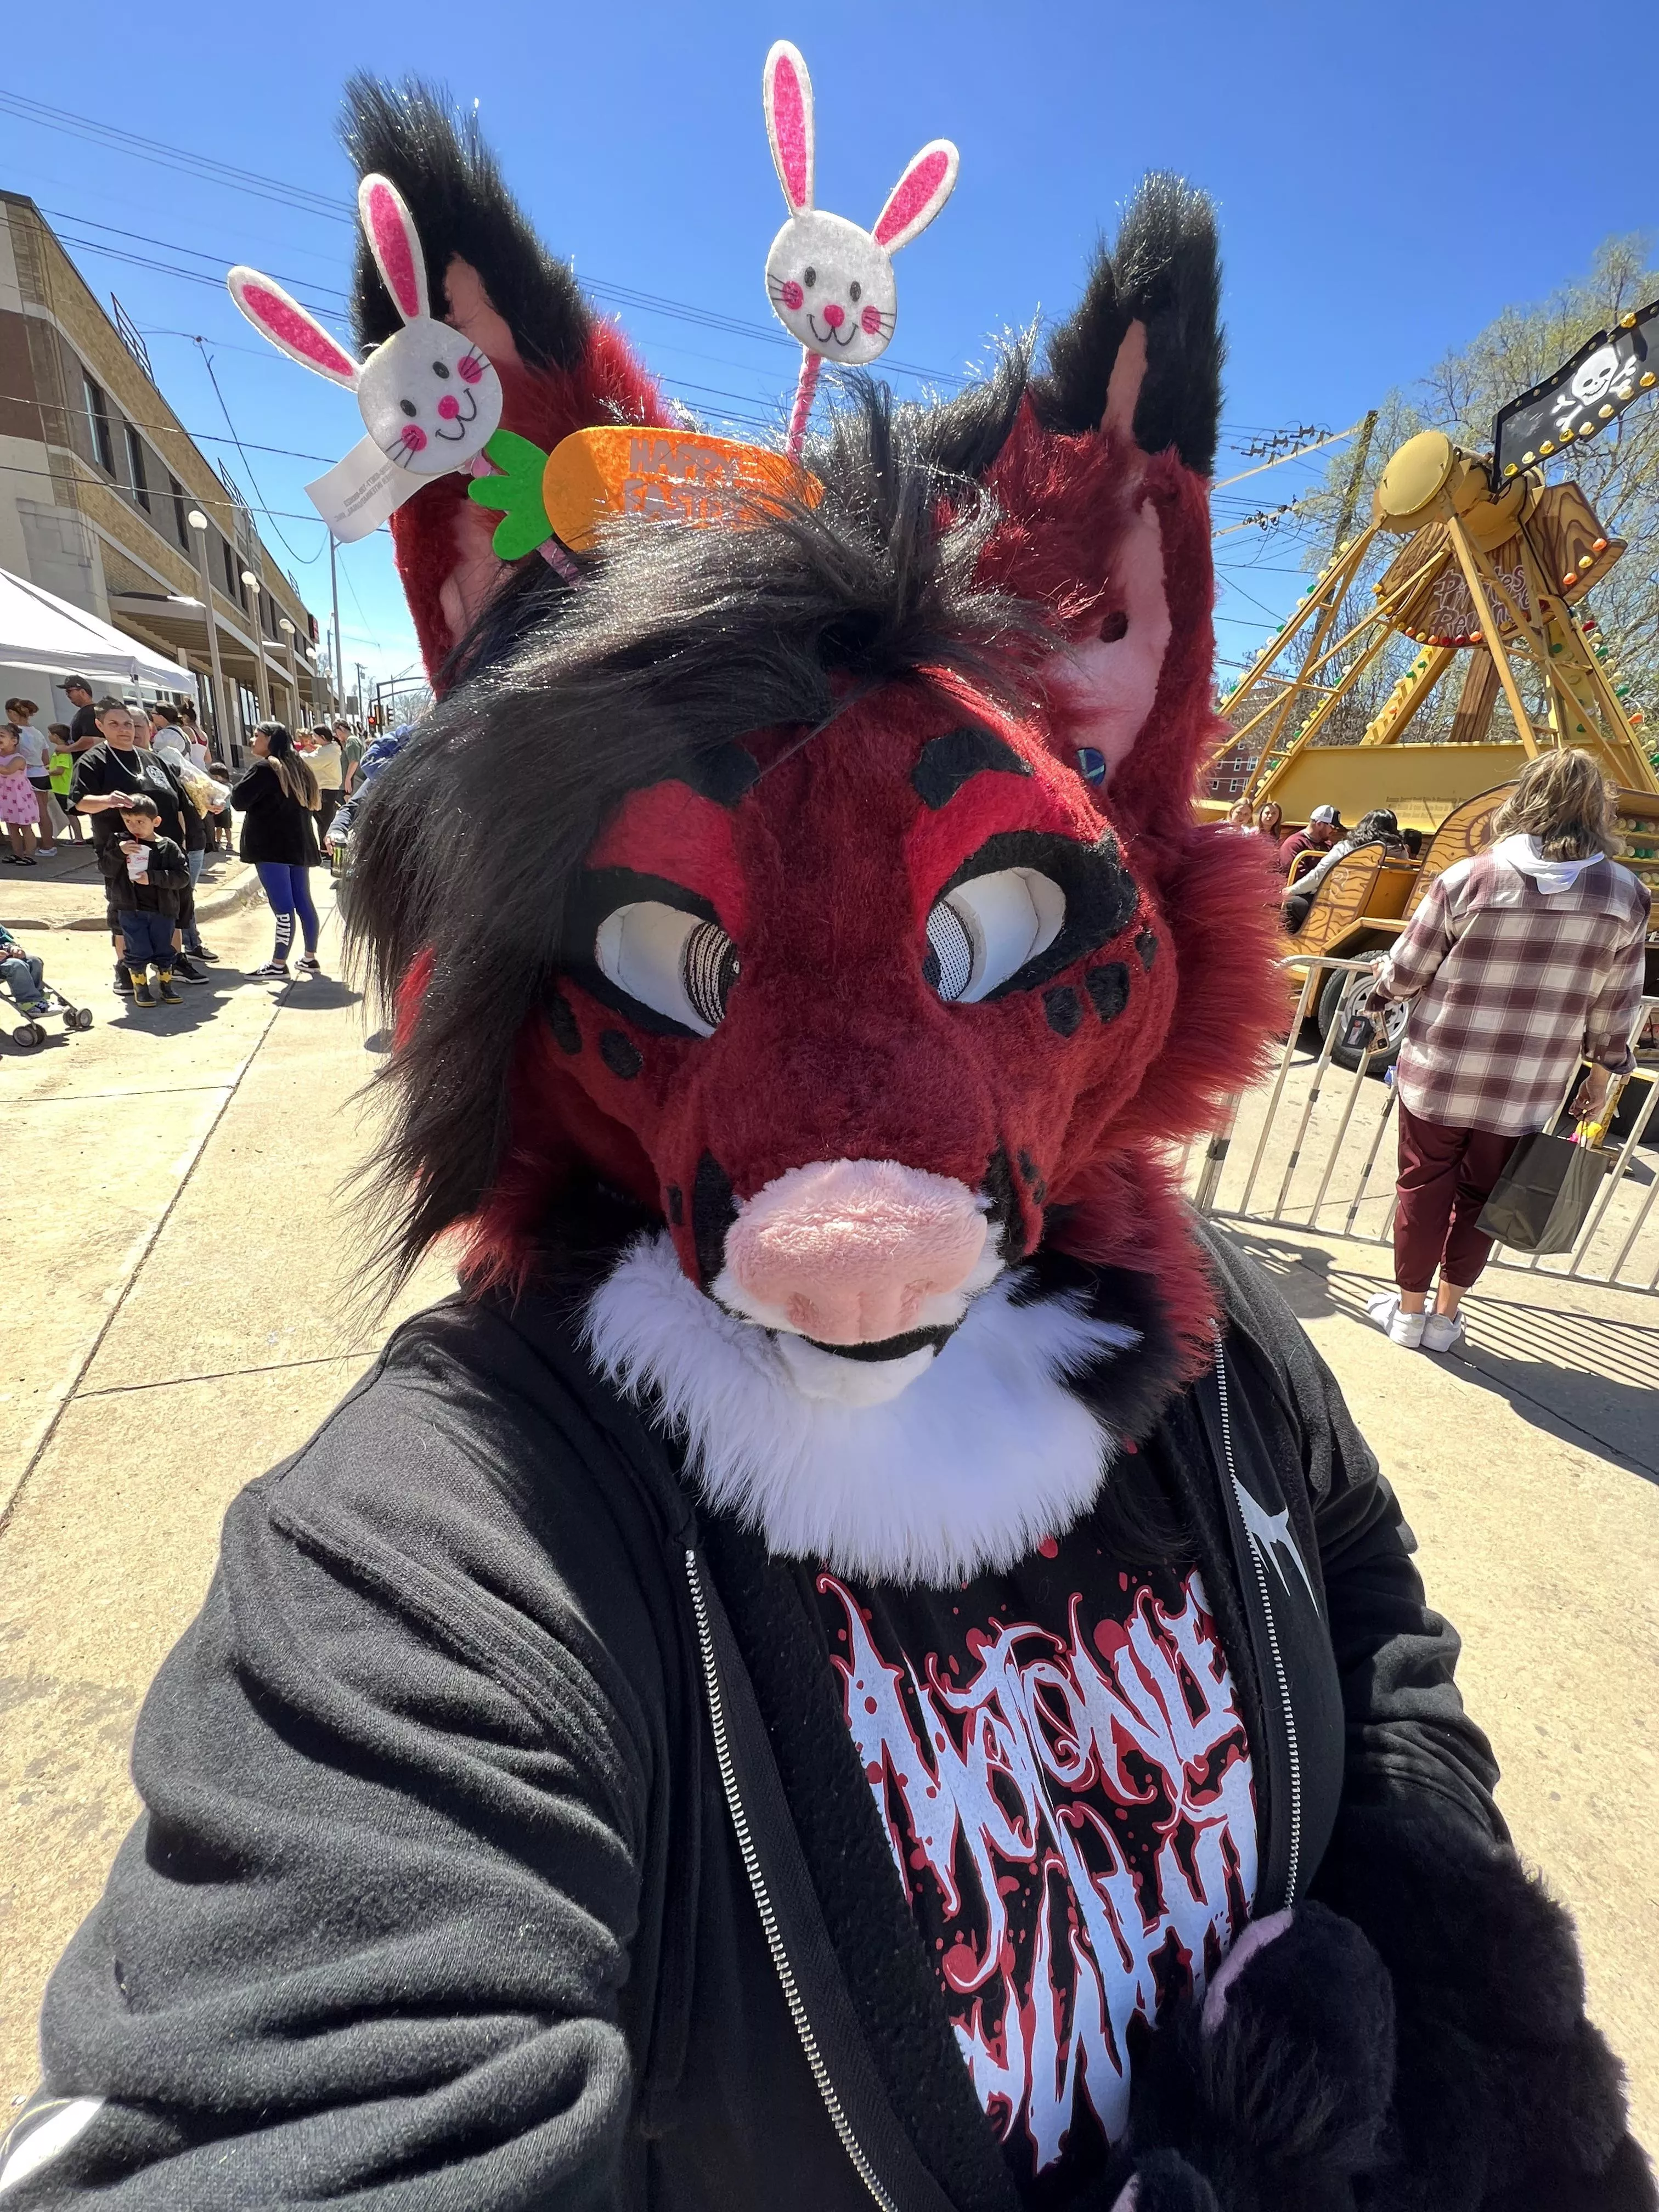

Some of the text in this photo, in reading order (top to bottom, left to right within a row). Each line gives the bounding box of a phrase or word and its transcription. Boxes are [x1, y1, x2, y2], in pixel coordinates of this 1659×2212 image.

[630, 438, 738, 486] HAPPY
[624, 478, 741, 526] EASTE
[1428, 588, 1530, 639] Revne
[276, 913, 291, 946] PINK
